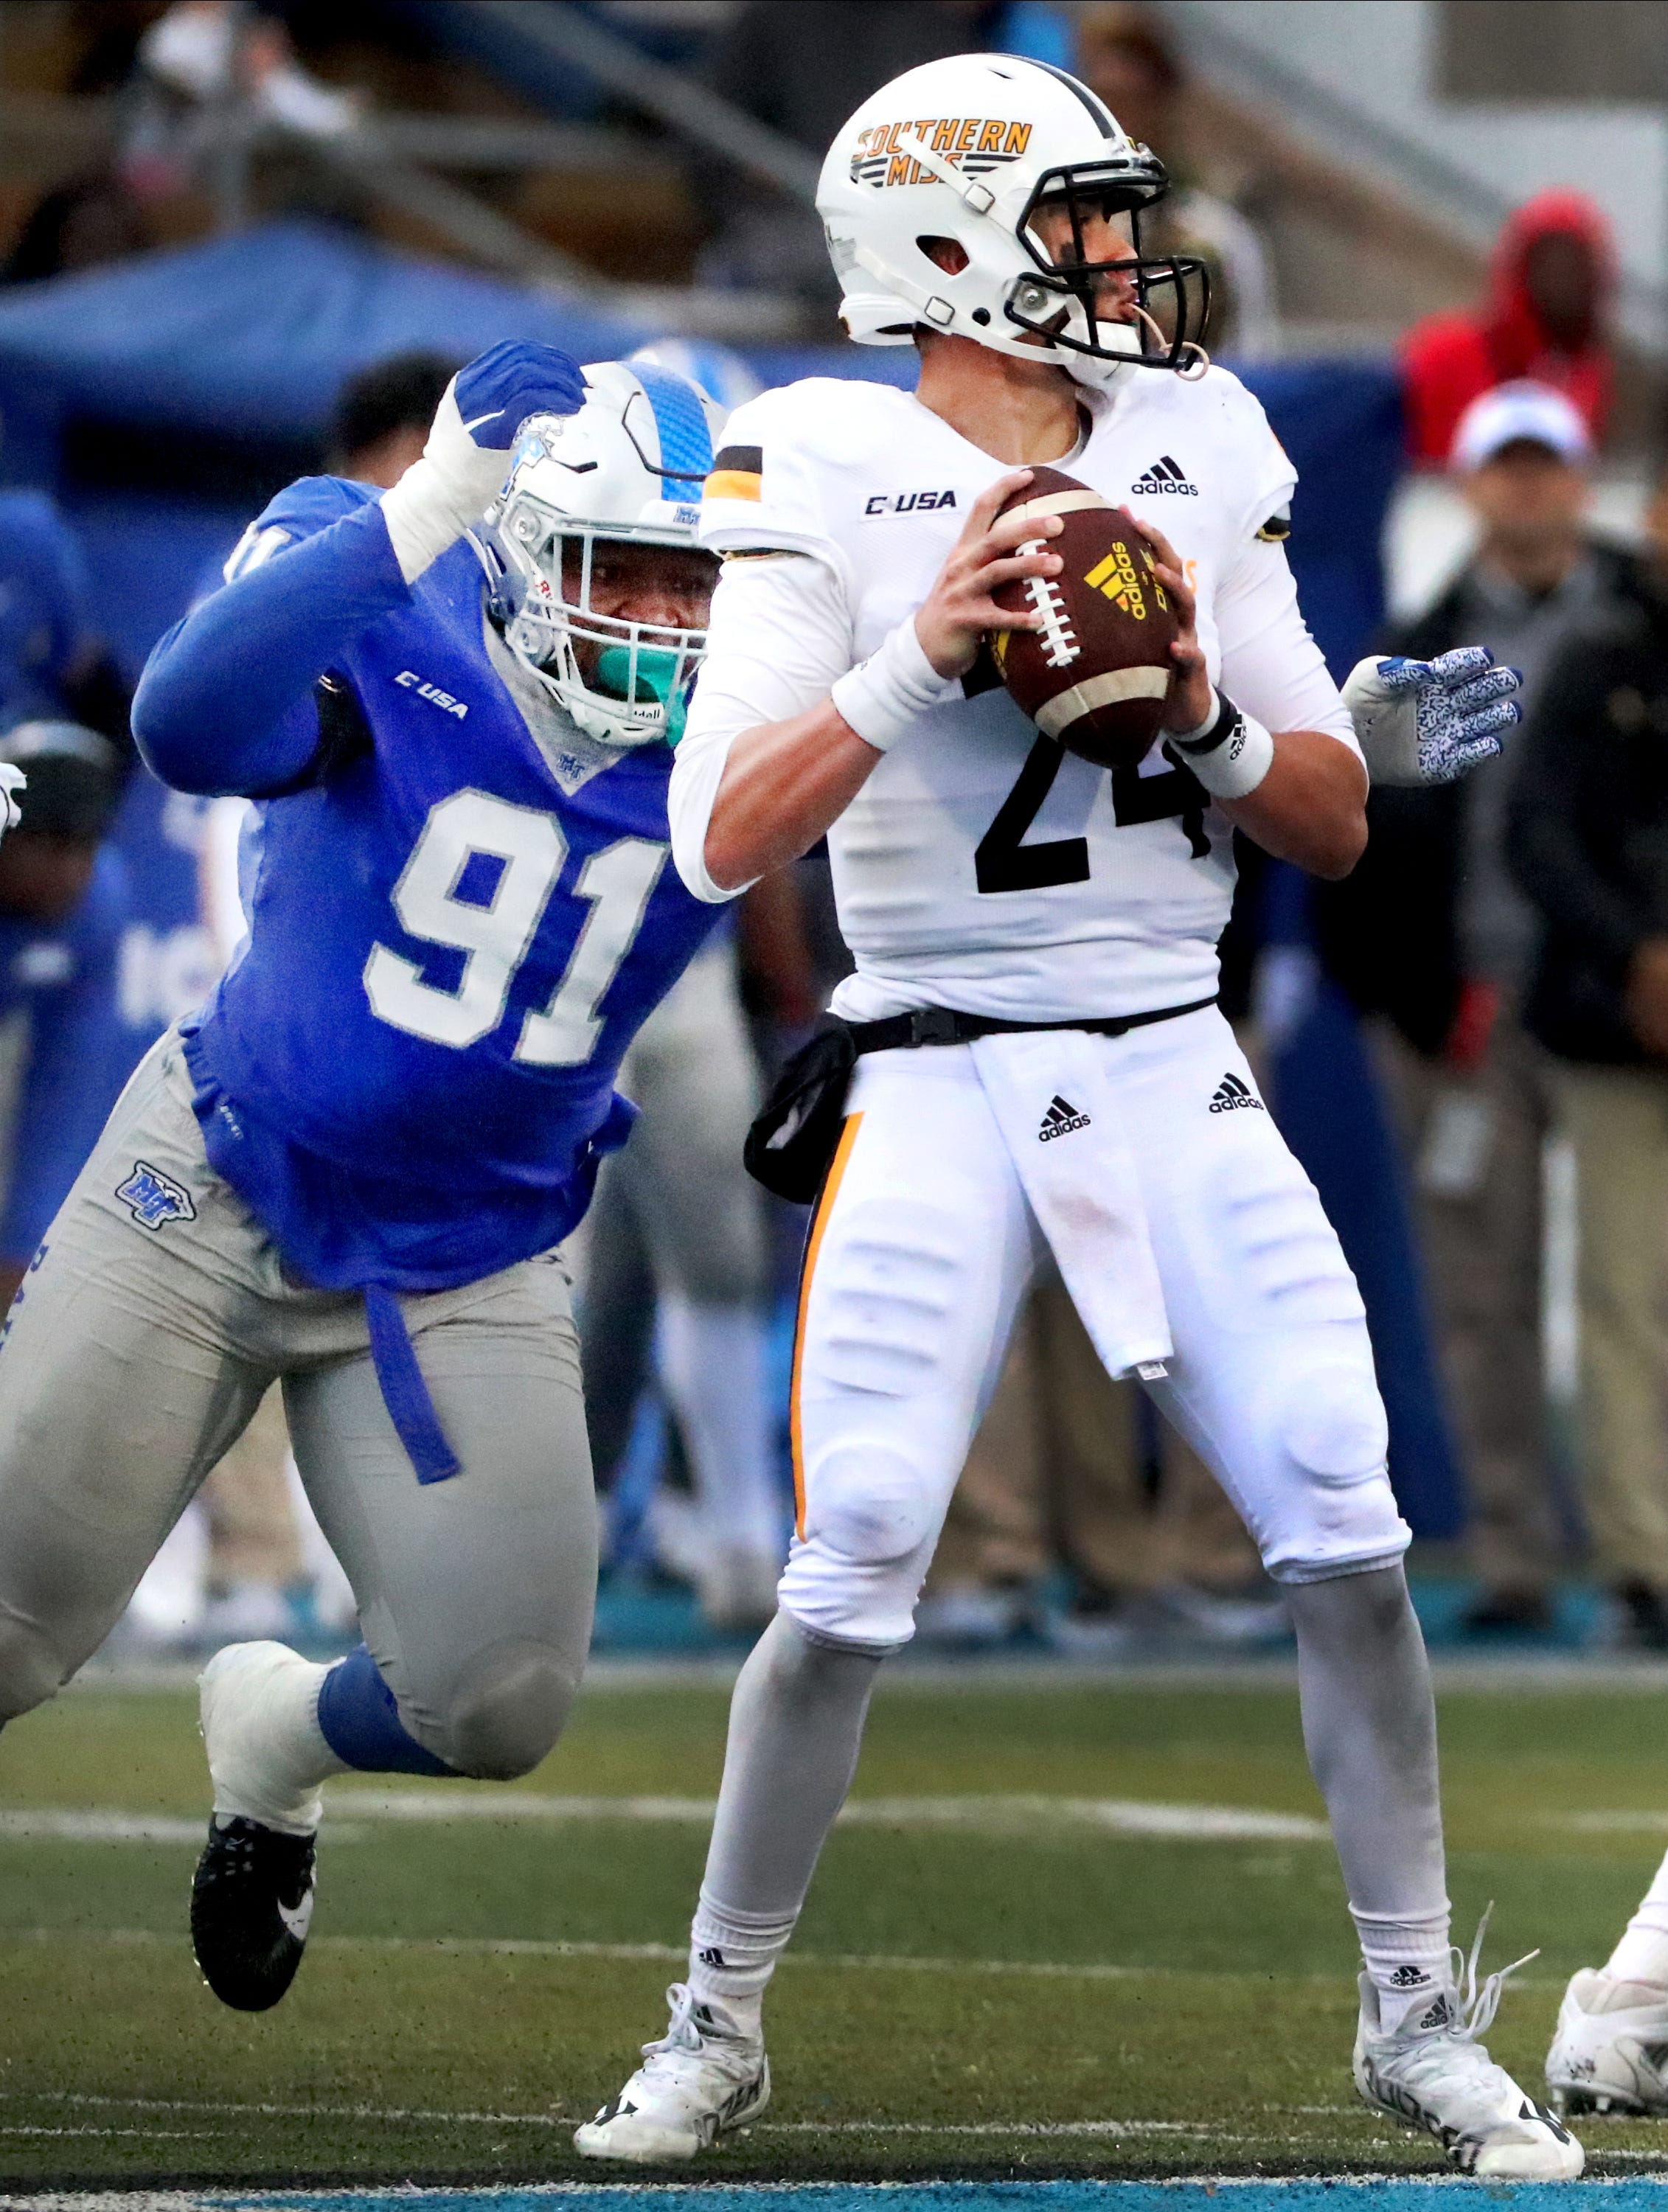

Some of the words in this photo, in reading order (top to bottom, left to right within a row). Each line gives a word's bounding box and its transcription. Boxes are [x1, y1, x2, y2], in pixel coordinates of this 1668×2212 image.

[850, 119, 1033, 162] SOUTHERN
[894, 490, 956, 512] USA
[1130, 479, 1199, 496] adidas
[1112, 541, 1146, 620] adidas
[417, 683, 468, 720] USA
[362, 786, 673, 1067] 91
[1038, 1114, 1091, 1143] adidas
[1420, 2013, 1448, 2029] adid
